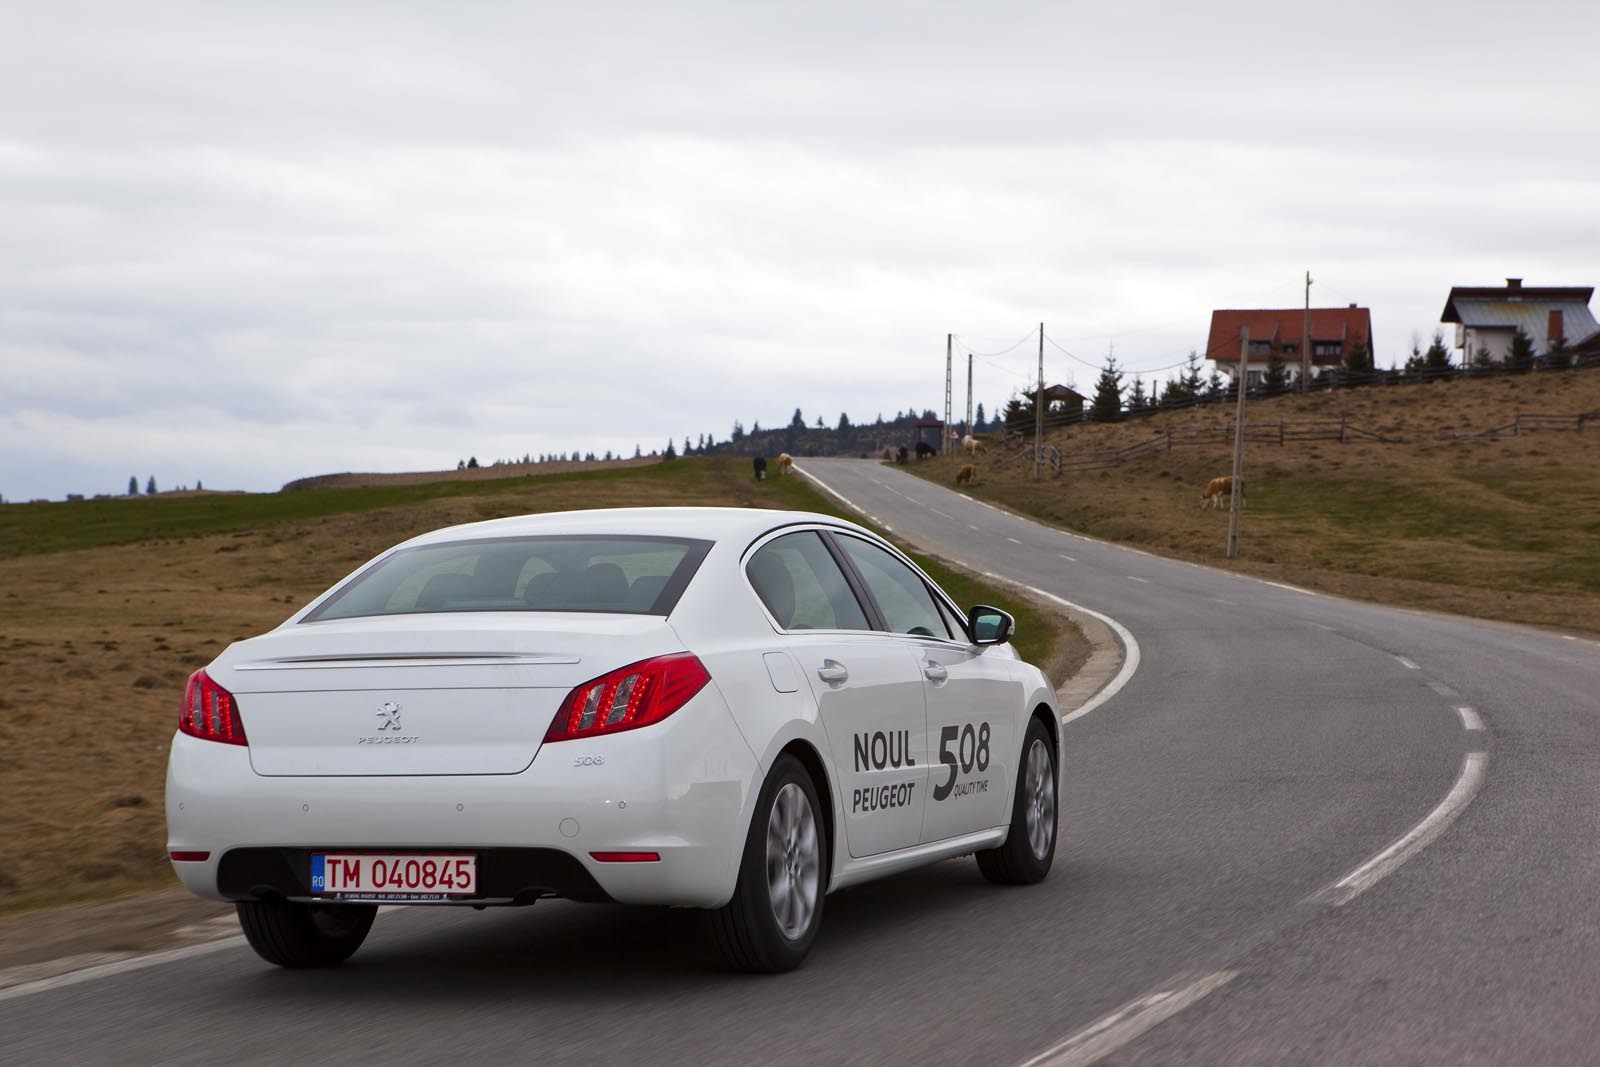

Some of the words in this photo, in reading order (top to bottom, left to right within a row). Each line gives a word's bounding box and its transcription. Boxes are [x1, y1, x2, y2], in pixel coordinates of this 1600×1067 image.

[358, 735, 419, 745] PEUGEOT
[854, 730, 916, 772] NOUL
[573, 753, 604, 768] 508
[933, 721, 991, 802] 508
[852, 782, 915, 814] PEUGEOT
[954, 780, 976, 800] QUALITY
[976, 779, 989, 792] TIME
[312, 876, 324, 888] RO
[327, 859, 361, 888] TM
[372, 859, 471, 889] 040845
